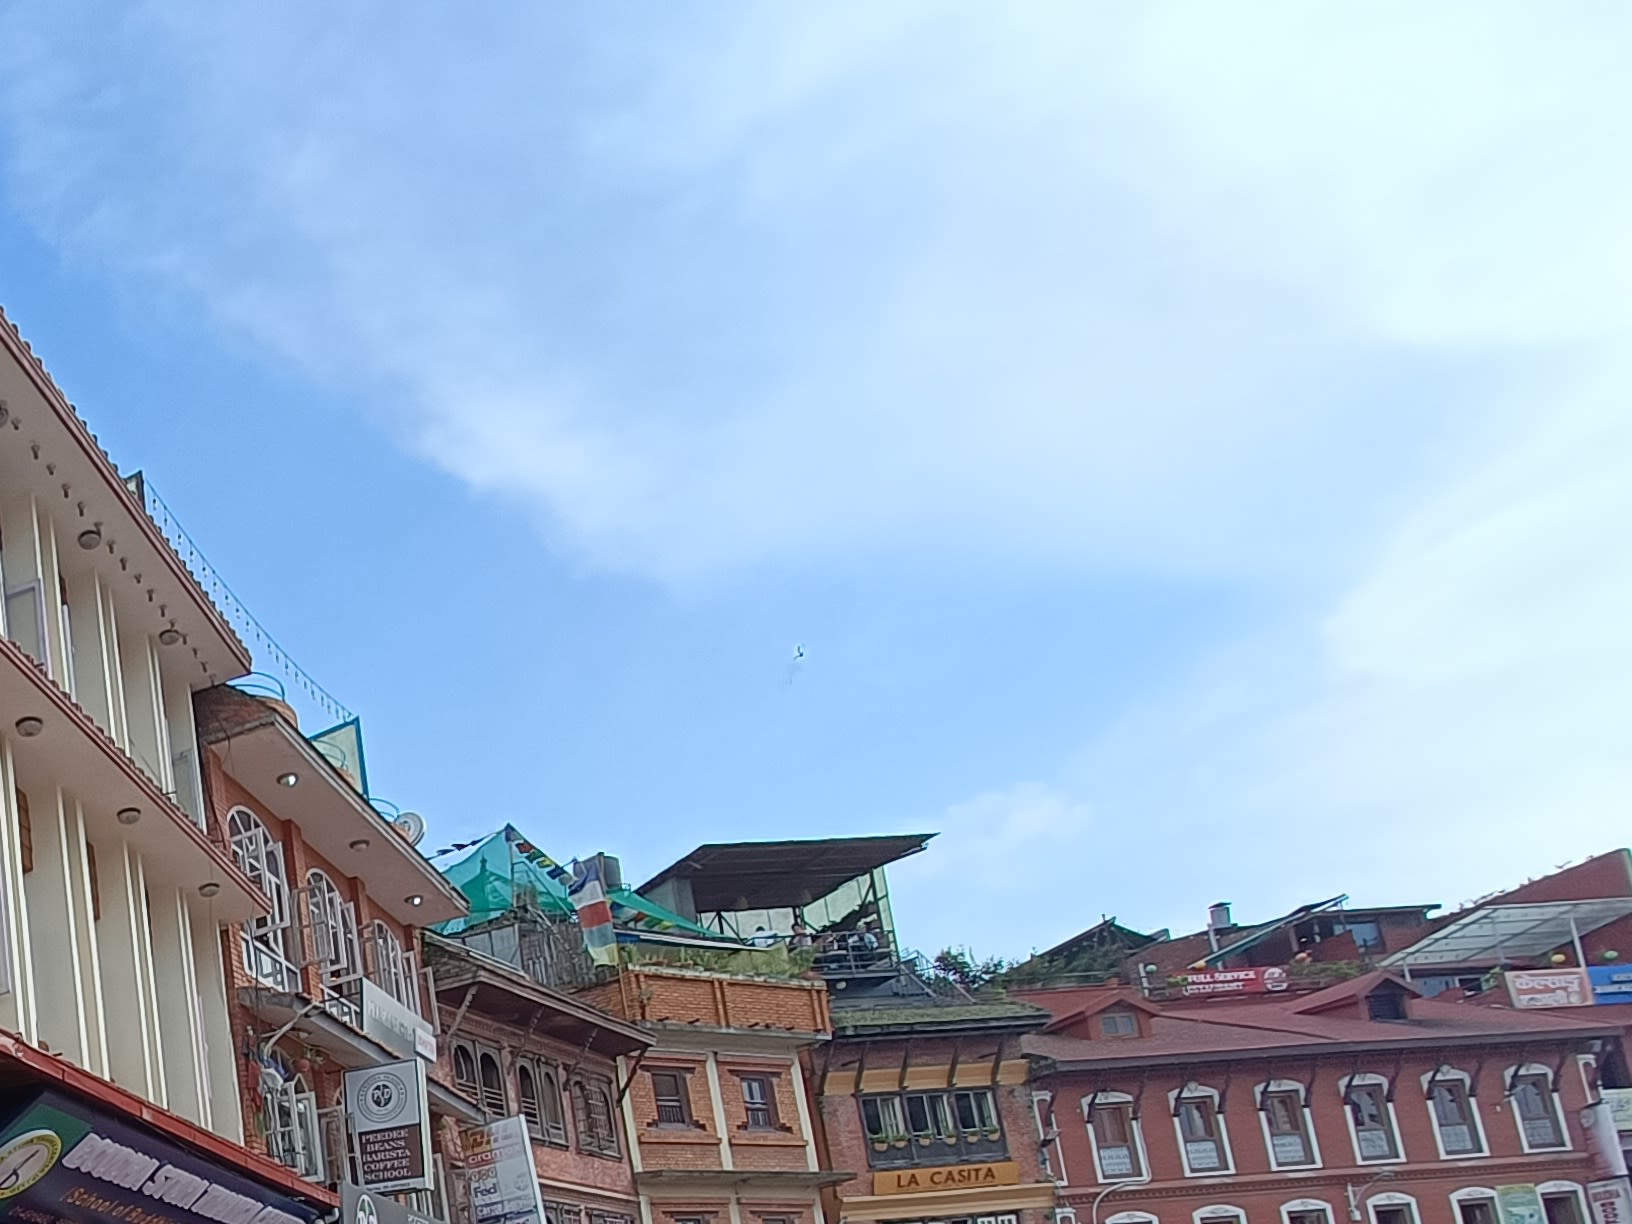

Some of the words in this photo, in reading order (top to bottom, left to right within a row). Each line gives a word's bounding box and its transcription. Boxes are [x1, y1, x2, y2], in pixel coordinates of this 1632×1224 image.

[361, 1128, 409, 1144] PEEDEE
[366, 1139, 406, 1153] BEANS
[362, 1148, 411, 1163] BARISTA
[364, 1158, 410, 1172] COFFEE
[364, 1167, 412, 1181] SCHOOL
[896, 1173, 920, 1188] LA
[930, 1167, 996, 1185] CASITA
